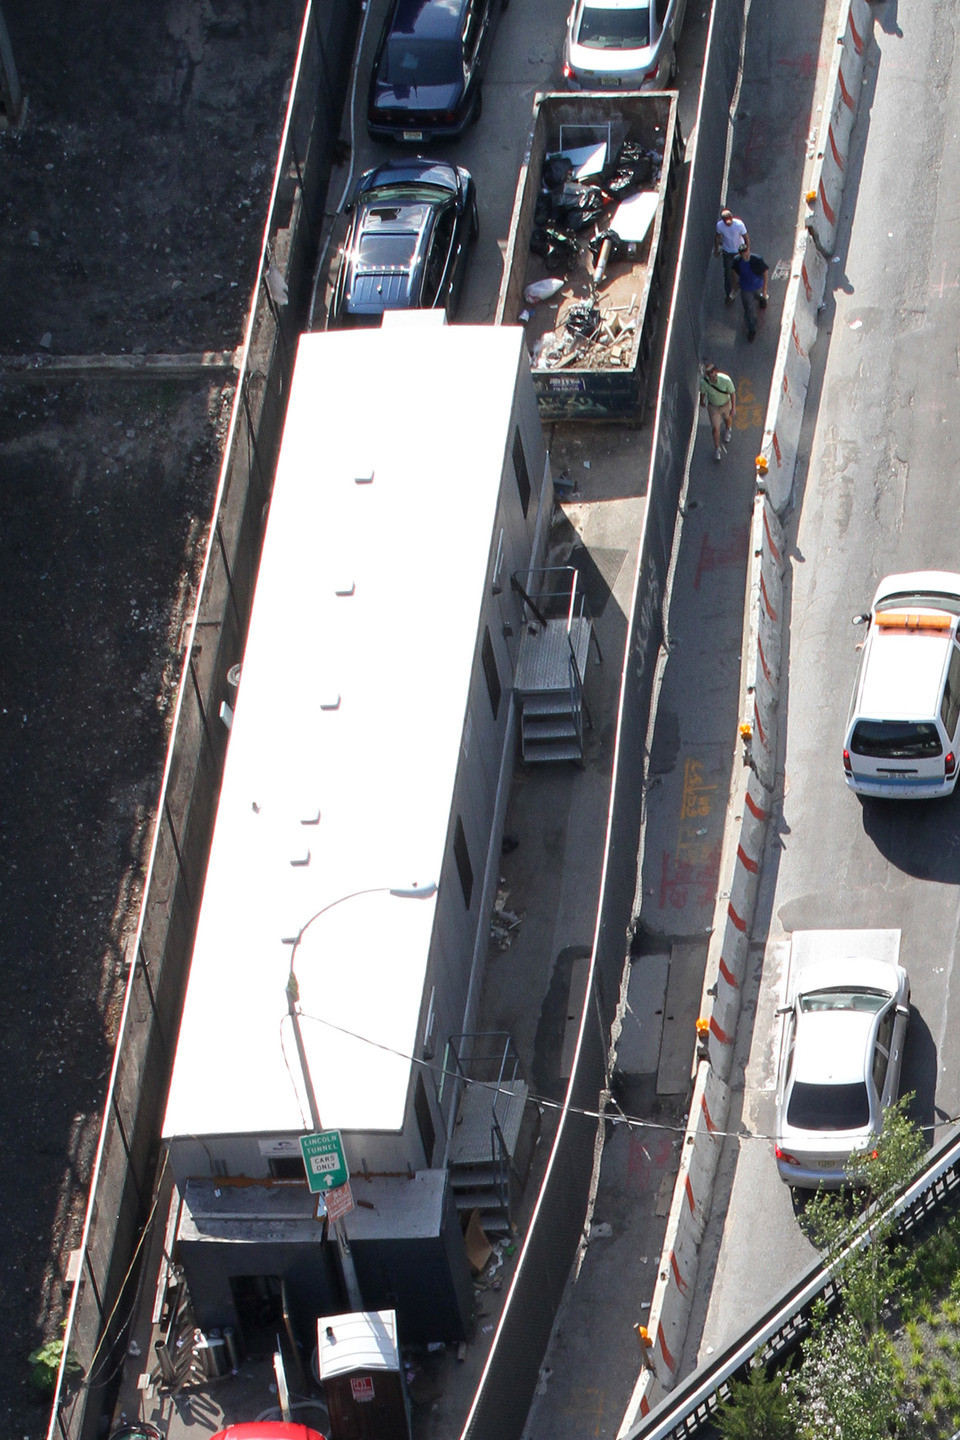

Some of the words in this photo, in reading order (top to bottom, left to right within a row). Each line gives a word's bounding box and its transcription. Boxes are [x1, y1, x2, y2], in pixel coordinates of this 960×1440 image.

[304, 1135, 337, 1147] LINCOLN
[306, 1144, 338, 1154] TUNNEL
[314, 1154, 336, 1165] CARS
[316, 1161, 336, 1172] ONLY
